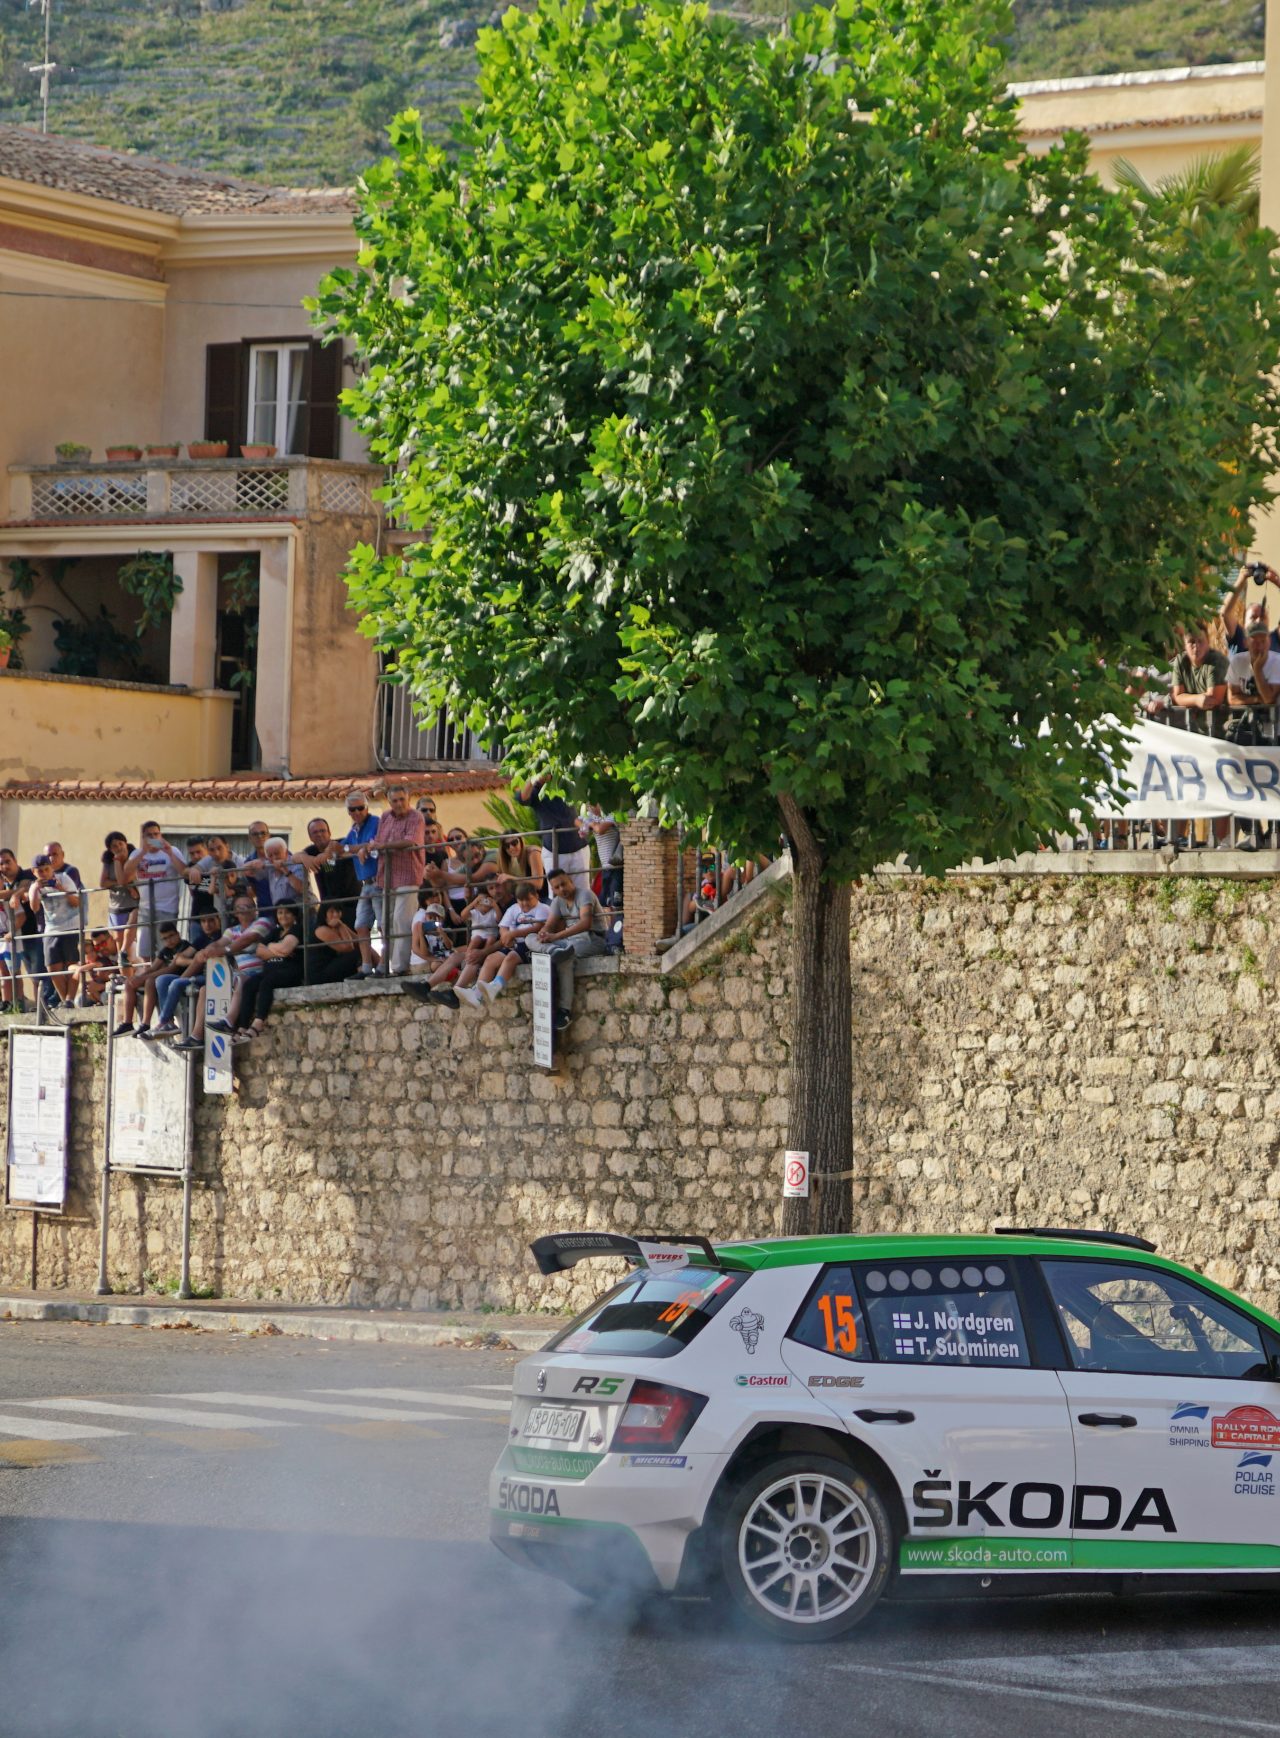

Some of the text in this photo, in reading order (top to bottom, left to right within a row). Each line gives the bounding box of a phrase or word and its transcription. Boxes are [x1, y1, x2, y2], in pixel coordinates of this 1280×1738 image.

[818, 1295, 858, 1353] 15
[914, 1311, 1014, 1335] J. Nordgren
[915, 1338, 1020, 1358] T. Suominen
[571, 1376, 626, 1396] R5
[749, 1375, 789, 1386] Castrol
[808, 1376, 865, 1388] EDGE
[1169, 1425, 1200, 1434] OMNIA
[1216, 1423, 1247, 1431] RALLY
[1169, 1437, 1210, 1448] SHIPPING
[1231, 1433, 1274, 1441] CAPITALE
[633, 1457, 684, 1466] MICHELIN
[1235, 1471, 1273, 1483] POLAR
[1234, 1484, 1276, 1496] CRUISE
[498, 1477, 562, 1517] ŠKODA
[912, 1469, 1178, 1533] ŠKODA
[908, 1546, 1068, 1563] www.skoda-auto.com
